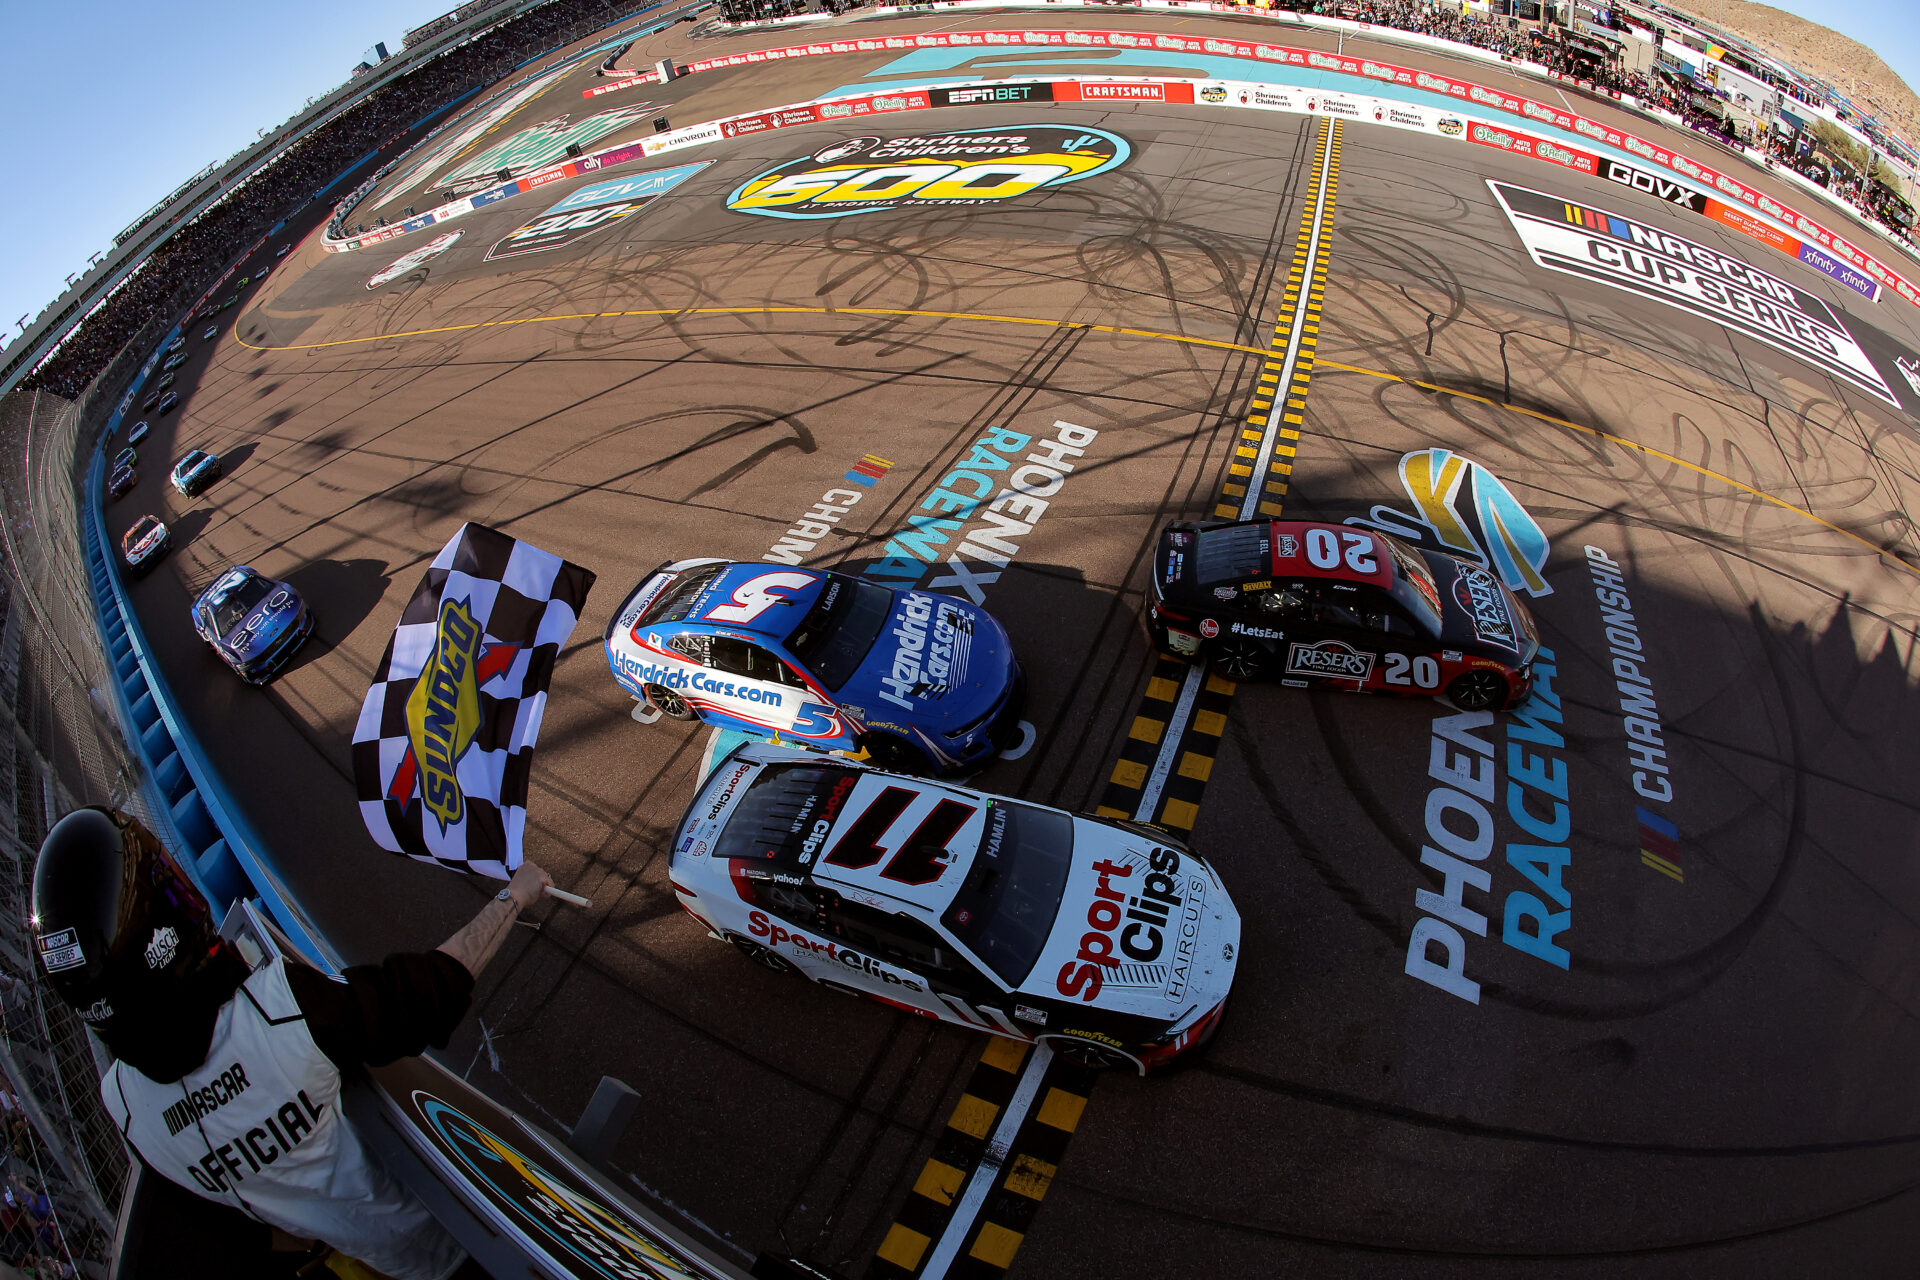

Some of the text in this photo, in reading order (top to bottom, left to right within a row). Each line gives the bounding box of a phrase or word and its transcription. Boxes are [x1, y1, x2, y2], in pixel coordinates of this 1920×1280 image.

[872, 97, 908, 110] O'Reilly
[949, 87, 1031, 103] ESPN BET
[1086, 86, 1162, 98] CRAFTSMAN
[1255, 91, 1288, 101] Shriners
[1323, 99, 1356, 109] Shriners
[736, 118, 761, 128] Shriners
[783, 110, 810, 119] Shriners
[820, 104, 854, 117] O'Reilly
[1390, 109, 1422, 120] Shriners
[669, 129, 717, 146] CHEVROLET
[883, 136, 1027, 149] Shriners
[1473, 124, 1514, 149] O'Reilly
[1513, 144, 1531, 153] PARTS
[1515, 139, 1531, 148] AUTO
[584, 156, 602, 170] ally
[870, 143, 1031, 158] Children's
[1536, 142, 1575, 165] O'Reilly
[1577, 156, 1591, 165] AUTO
[531, 169, 563, 186] CRAFTSMAN
[1574, 161, 1592, 171] PARTS
[1607, 162, 1702, 209] GOVX
[826, 200, 898, 209] PHOENIX
[902, 199, 996, 208] RACEWAY
[1723, 211, 1743, 224] DESERT
[1744, 219, 1766, 234] DIAMOND
[1766, 231, 1784, 244] CASINO
[1629, 225, 1802, 309] NASCAR
[1804, 249, 1837, 275] xfinity
[1840, 270, 1870, 294] xfinity
[1588, 240, 1839, 356] CUP SERIES
[928, 419, 1099, 606] PHOENIX
[1306, 528, 1380, 574] 20
[689, 592, 710, 619] TECHS
[702, 571, 820, 624] 5
[821, 582, 841, 612] LARSON
[230, 591, 288, 649] eero
[1231, 622, 1285, 640] #LetsEat
[879, 592, 933, 712] Hendrick
[1384, 652, 1439, 689] 20
[1584, 544, 1673, 803] CHAMPIONSHIP
[424, 608, 472, 814] SUNOCO
[790, 700, 838, 736] 5
[866, 720, 910, 735] GOODYEAR
[1503, 645, 1572, 971] RACEWA
[798, 820, 830, 864] Clips
[823, 786, 978, 885] 11
[987, 807, 1008, 858] HAMLIN
[1405, 696, 1495, 1006] PHOEN
[773, 873, 804, 885] yahoo!
[1120, 847, 1184, 963] Clips
[1056, 859, 1134, 1002] Sport
[1168, 880, 1203, 998] HAIRCUTS
[55, 950, 75, 963] SERIES
[145, 928, 179, 968] BUSCH
[159, 950, 177, 969] LIGHT
[1063, 1027, 1124, 1048] GOODYEAR
[184, 1063, 250, 1130] NASCAR
[187, 1090, 324, 1193] OFFICIAL
